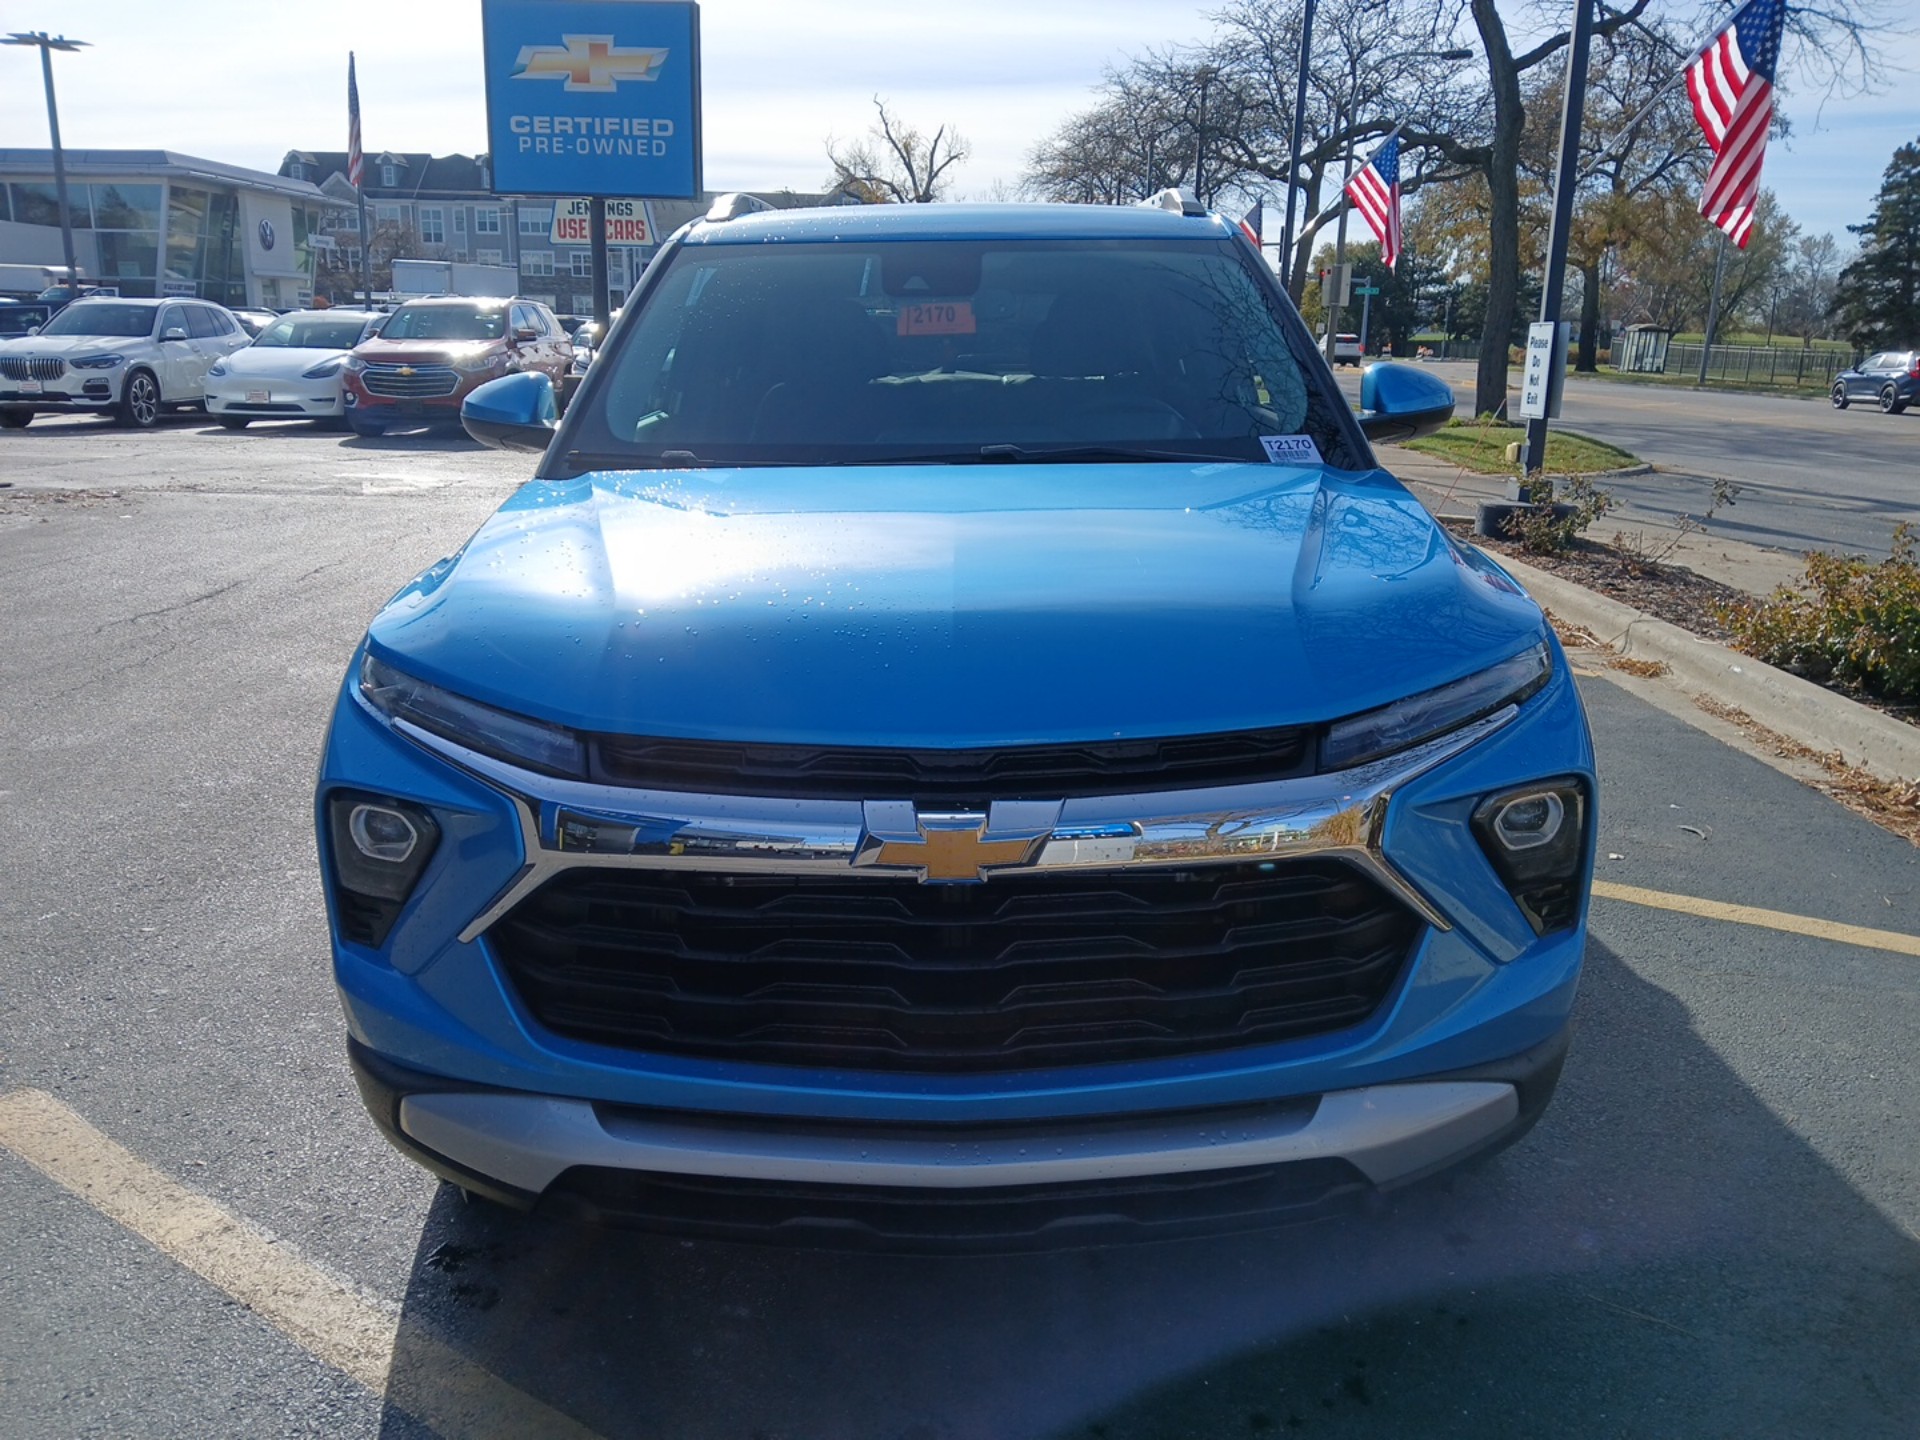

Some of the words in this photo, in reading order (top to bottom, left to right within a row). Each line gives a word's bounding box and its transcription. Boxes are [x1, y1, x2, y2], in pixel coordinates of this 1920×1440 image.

[510, 115, 674, 137] CERTIFIED
[519, 136, 666, 157] PRE-OWNED
[567, 201, 633, 217] JENNGS
[605, 219, 646, 241] CARS
[914, 305, 956, 324] 2170
[1530, 336, 1549, 349] Please
[1532, 355, 1541, 368] Do
[1529, 374, 1540, 386] Not
[1526, 392, 1538, 405] Exit
[1265, 439, 1312, 451] T2170
